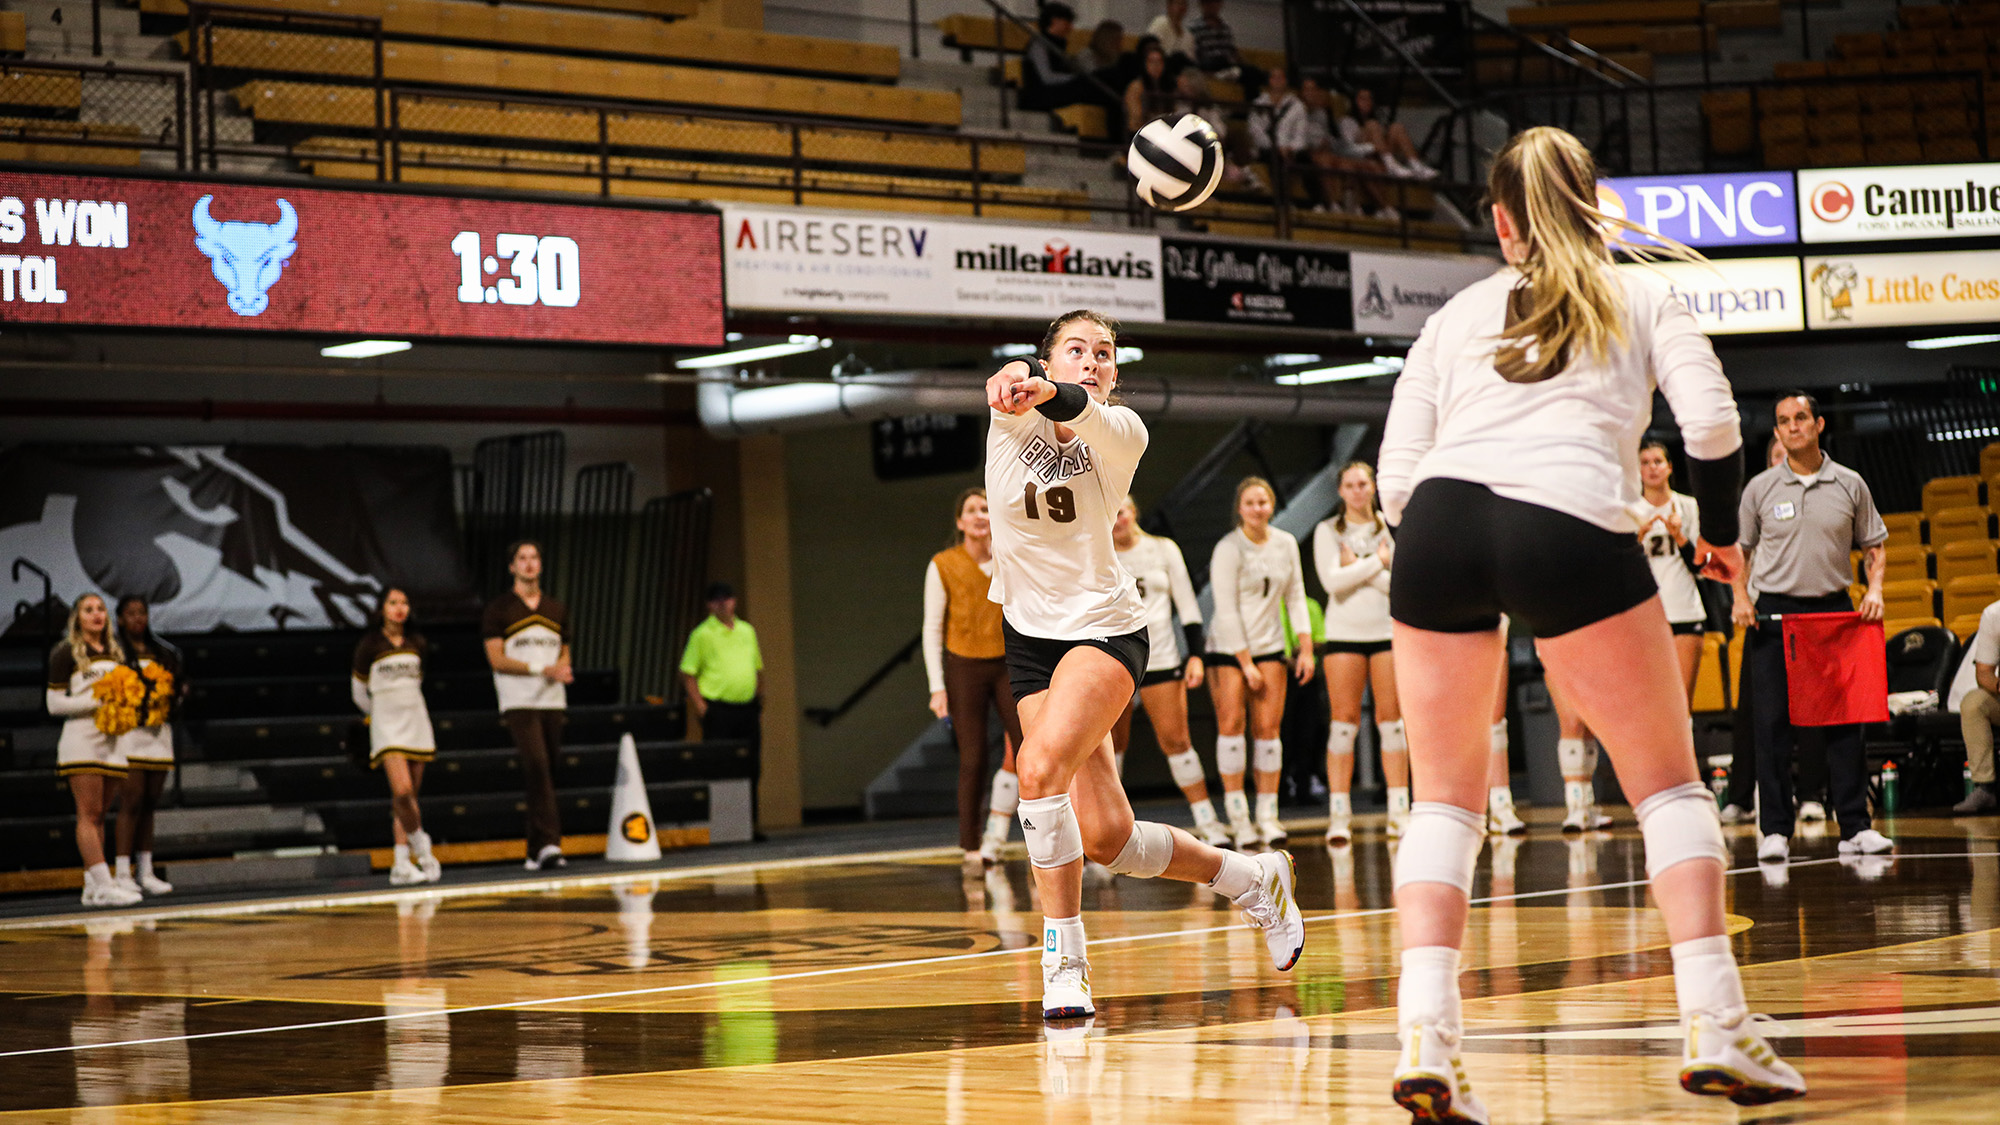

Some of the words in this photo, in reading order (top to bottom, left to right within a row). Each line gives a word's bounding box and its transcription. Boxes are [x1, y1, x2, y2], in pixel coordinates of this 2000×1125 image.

[34, 197, 129, 249] WON
[1635, 181, 1786, 240] PNC
[736, 218, 927, 258] AIRESERV
[0, 254, 67, 303] TOL
[451, 230, 580, 308] 1:30
[1865, 273, 1935, 304] Little
[1024, 481, 1077, 523] 19
[1651, 535, 1675, 556] 21
